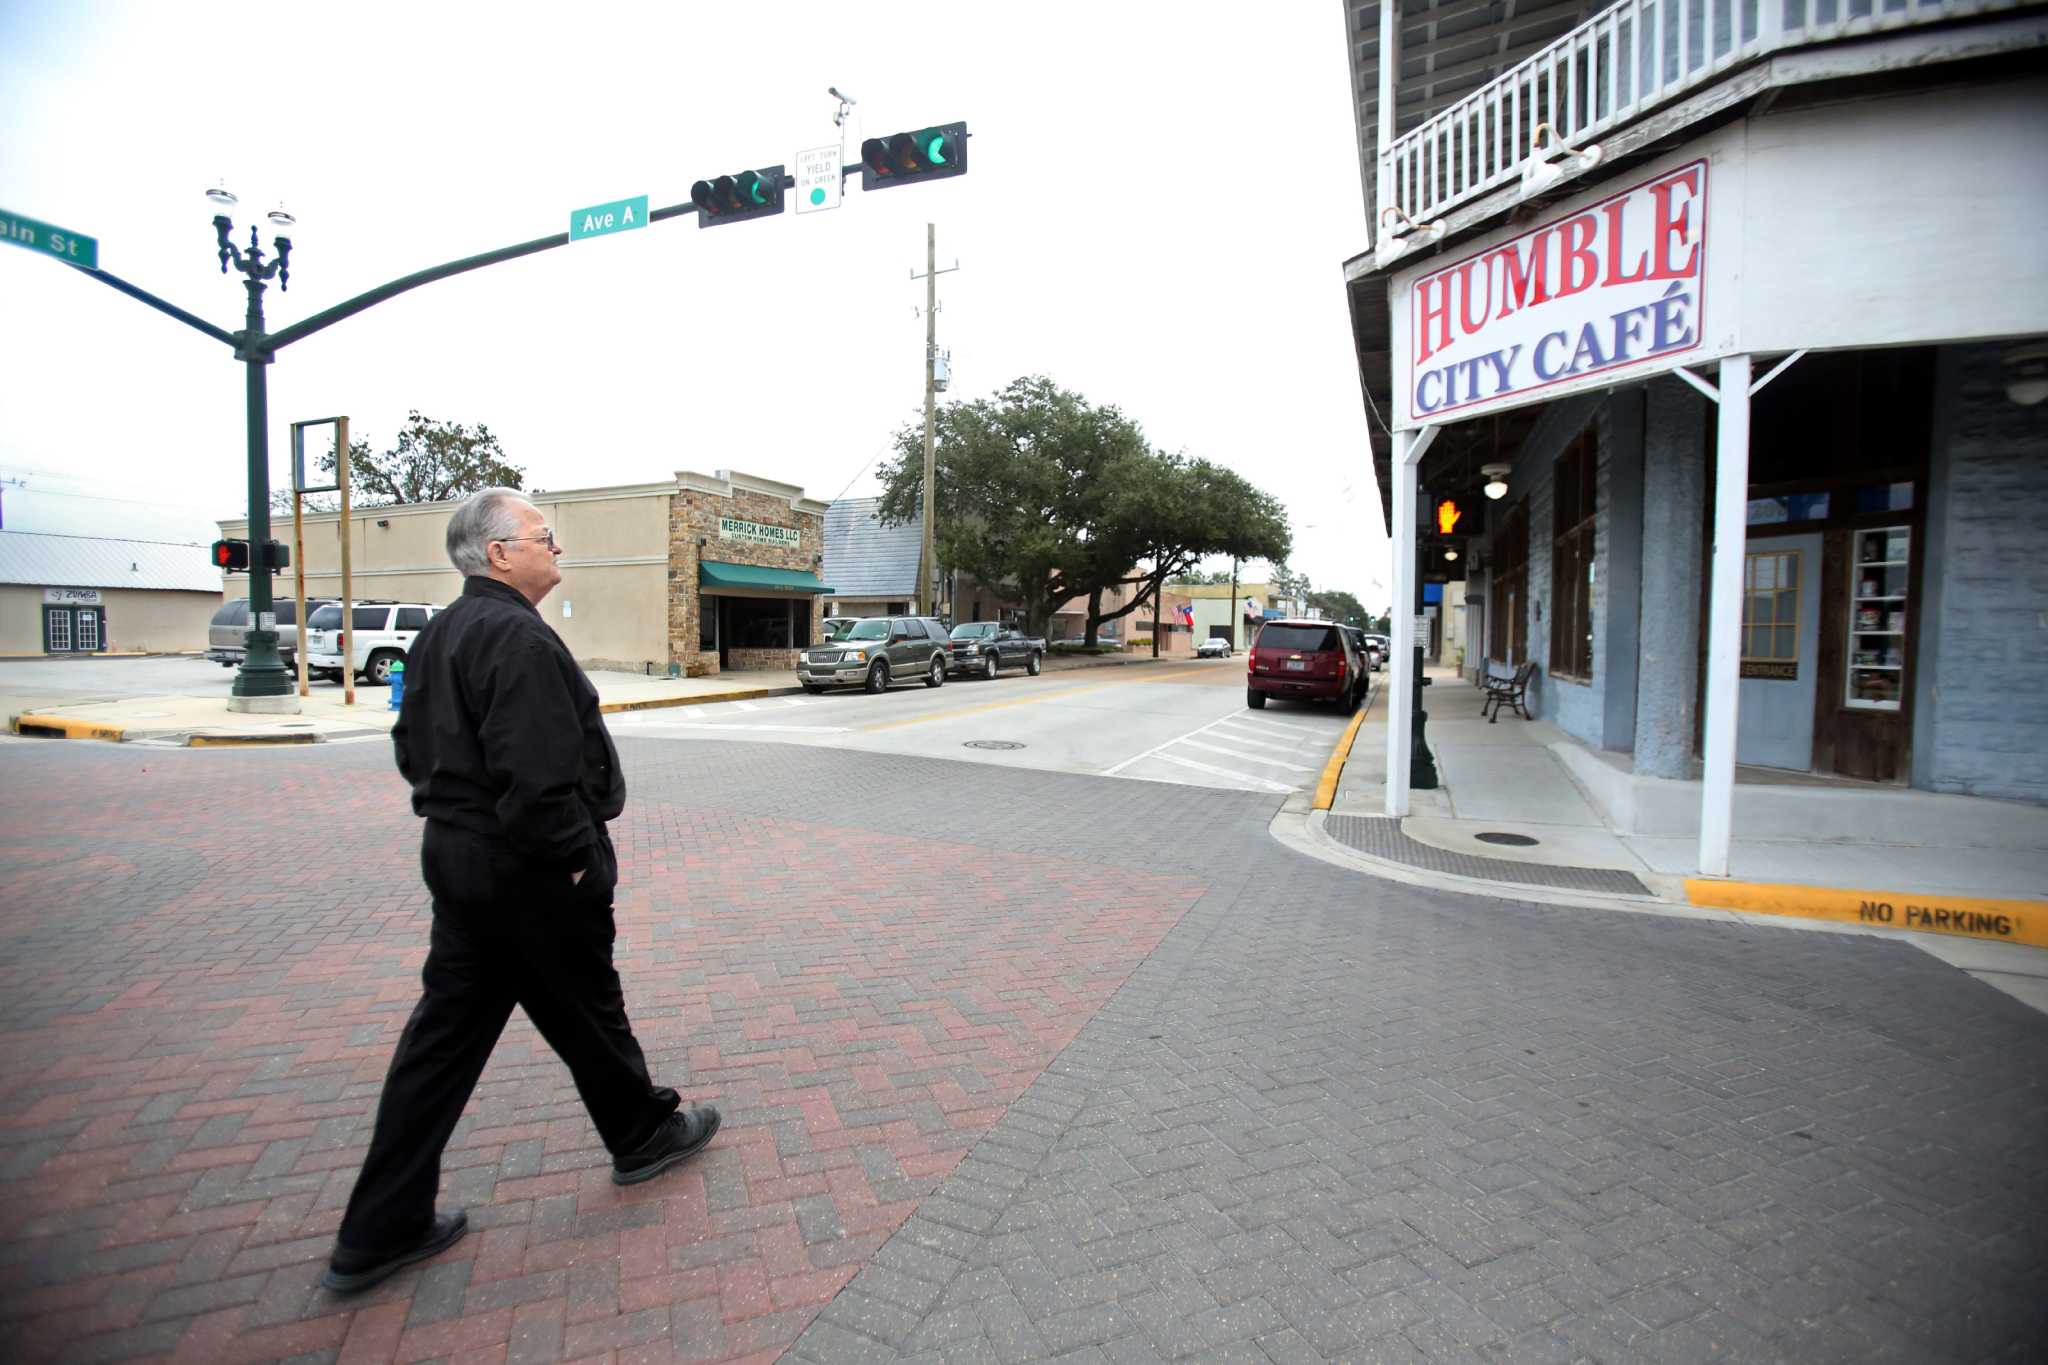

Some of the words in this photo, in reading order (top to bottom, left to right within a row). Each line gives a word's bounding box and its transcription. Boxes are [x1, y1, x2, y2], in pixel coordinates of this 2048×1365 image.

[806, 161, 831, 175] YIELD
[583, 213, 614, 233] Ave
[622, 204, 635, 225] A
[50, 232, 79, 257] St
[1416, 169, 1698, 366] HUMBLE
[1416, 343, 1521, 413] CITY
[1533, 281, 1691, 382] CAFÉ
[721, 519, 757, 536] MERRICK
[759, 527, 784, 540] HOMES
[785, 529, 798, 542] LLC
[1859, 900, 1892, 923] NO
[1905, 905, 2012, 936] PARKING
